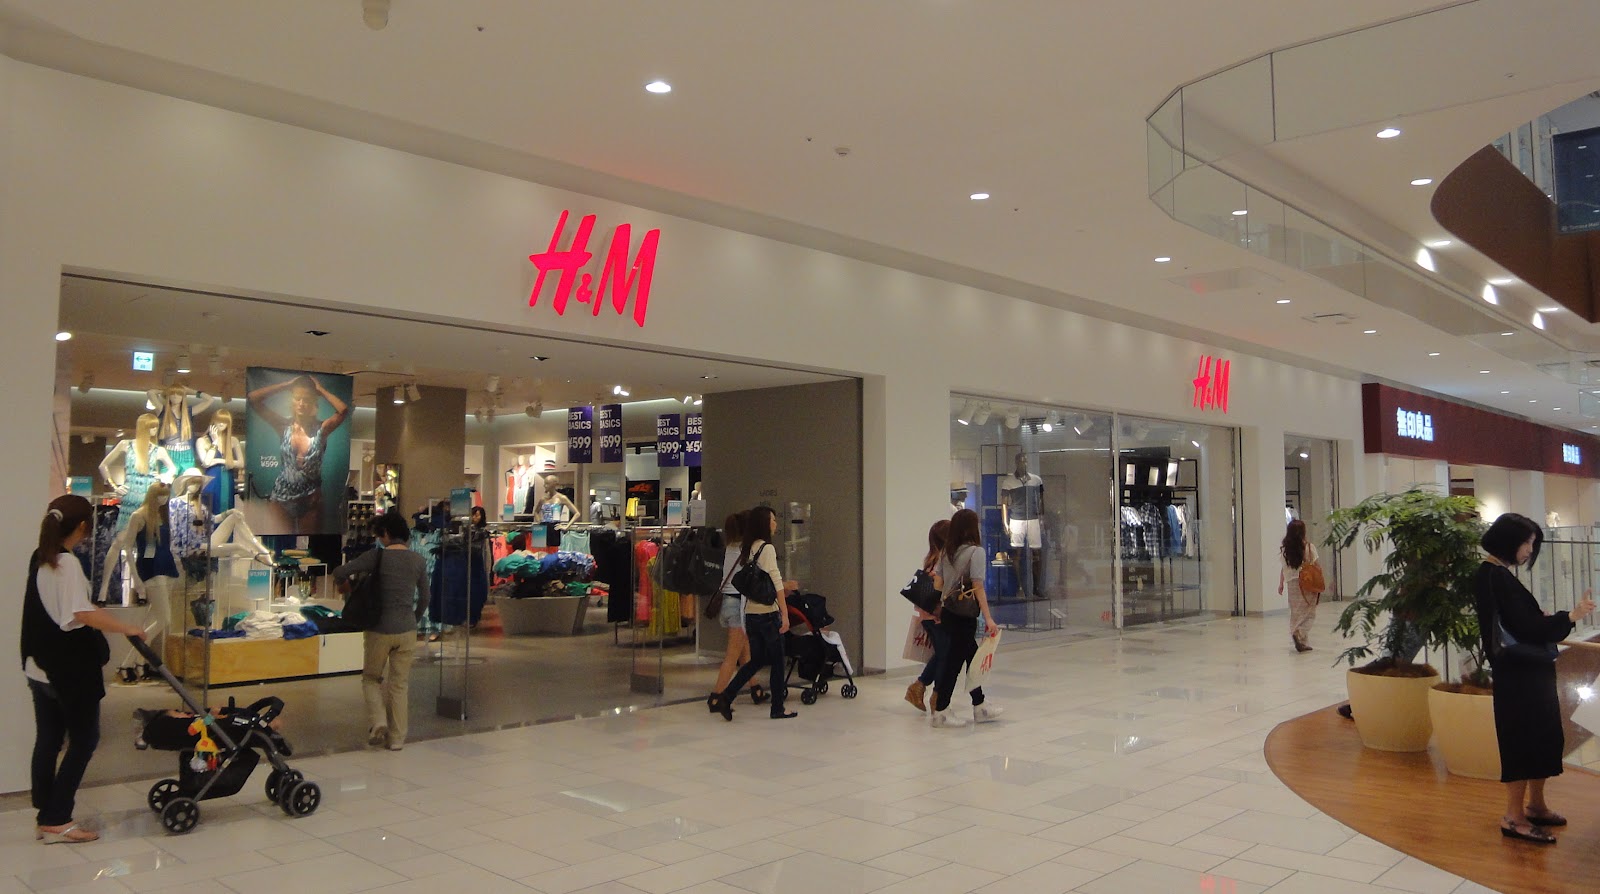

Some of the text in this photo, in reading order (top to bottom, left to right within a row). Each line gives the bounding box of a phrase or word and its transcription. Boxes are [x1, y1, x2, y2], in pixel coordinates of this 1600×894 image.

[529, 209, 661, 328] H&M
[1192, 354, 1231, 415] H&M
[686, 426, 702, 435] BAS
[687, 416, 702, 426] BES
[1396, 406, 1434, 442] 無印良品
